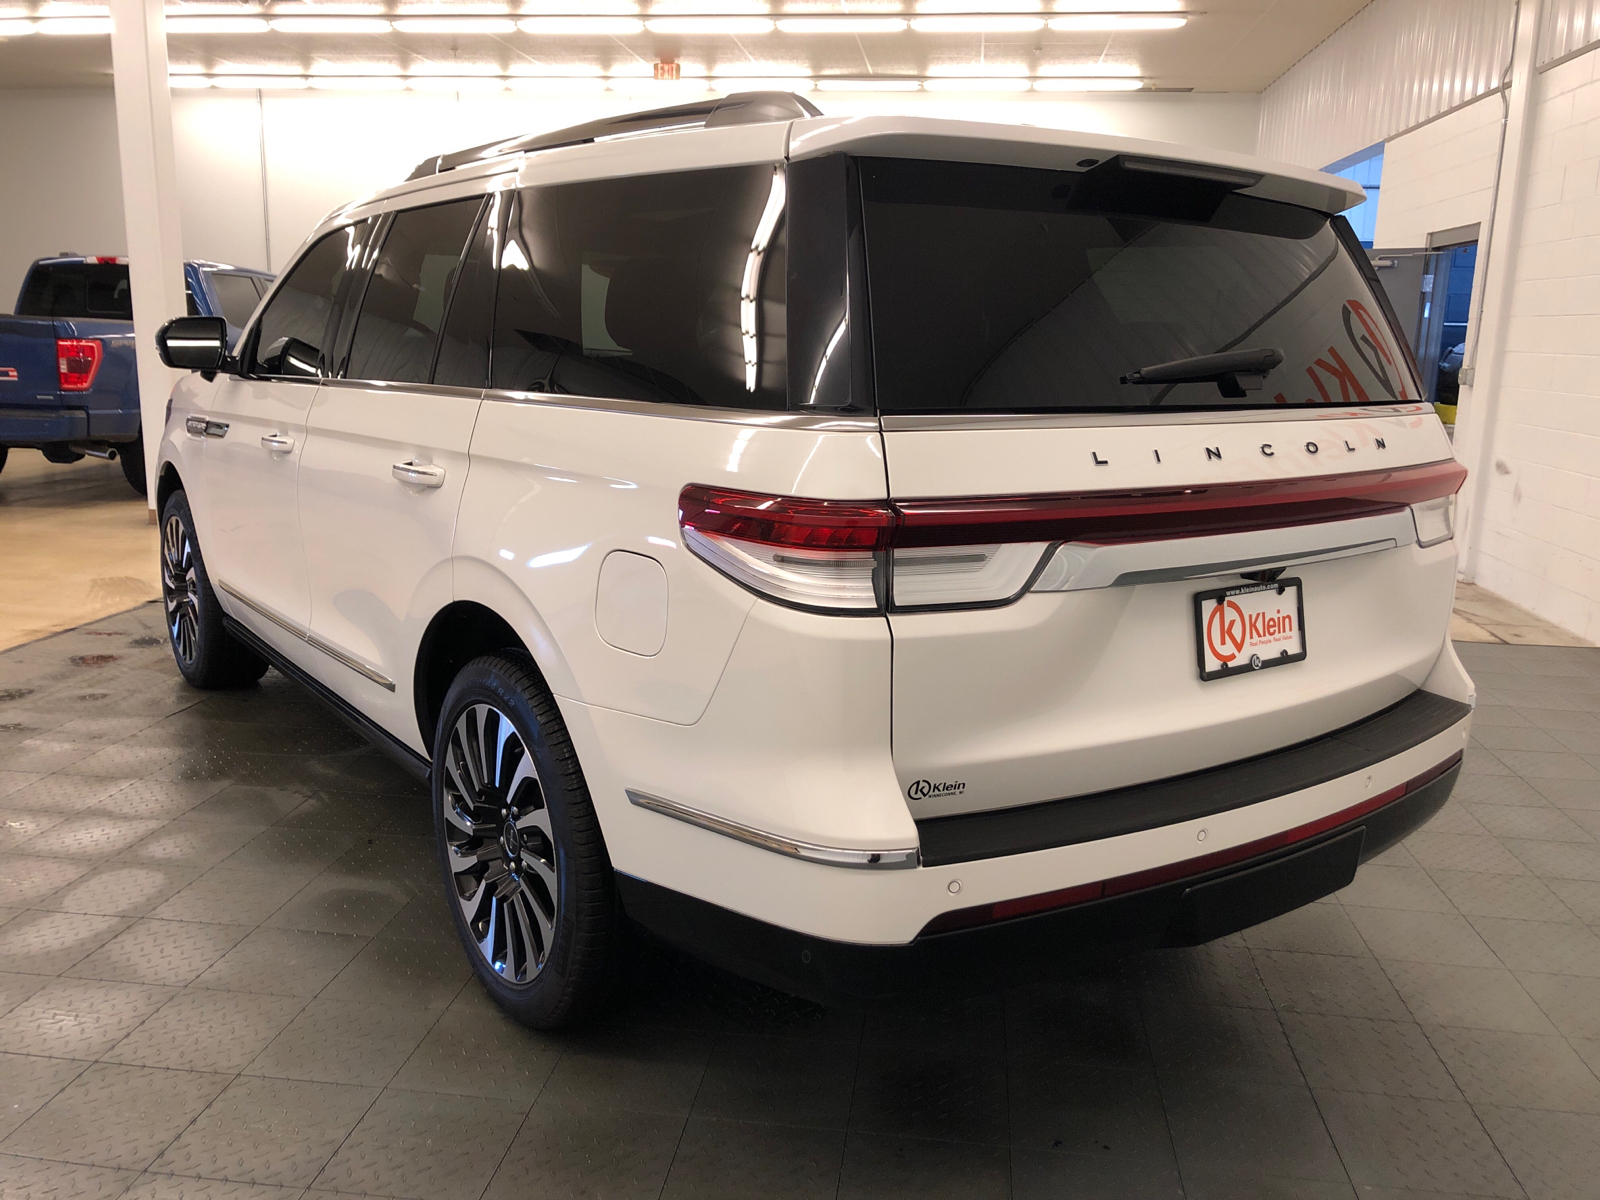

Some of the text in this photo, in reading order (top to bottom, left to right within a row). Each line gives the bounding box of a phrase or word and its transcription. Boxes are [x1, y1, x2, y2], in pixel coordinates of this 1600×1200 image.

[657, 63, 677, 79] EXIT
[1091, 437, 1387, 466] LINCOLN
[1226, 583, 1279, 596] www.kleinauto.com
[1248, 609, 1293, 640] Klein
[932, 780, 966, 793] Klein
